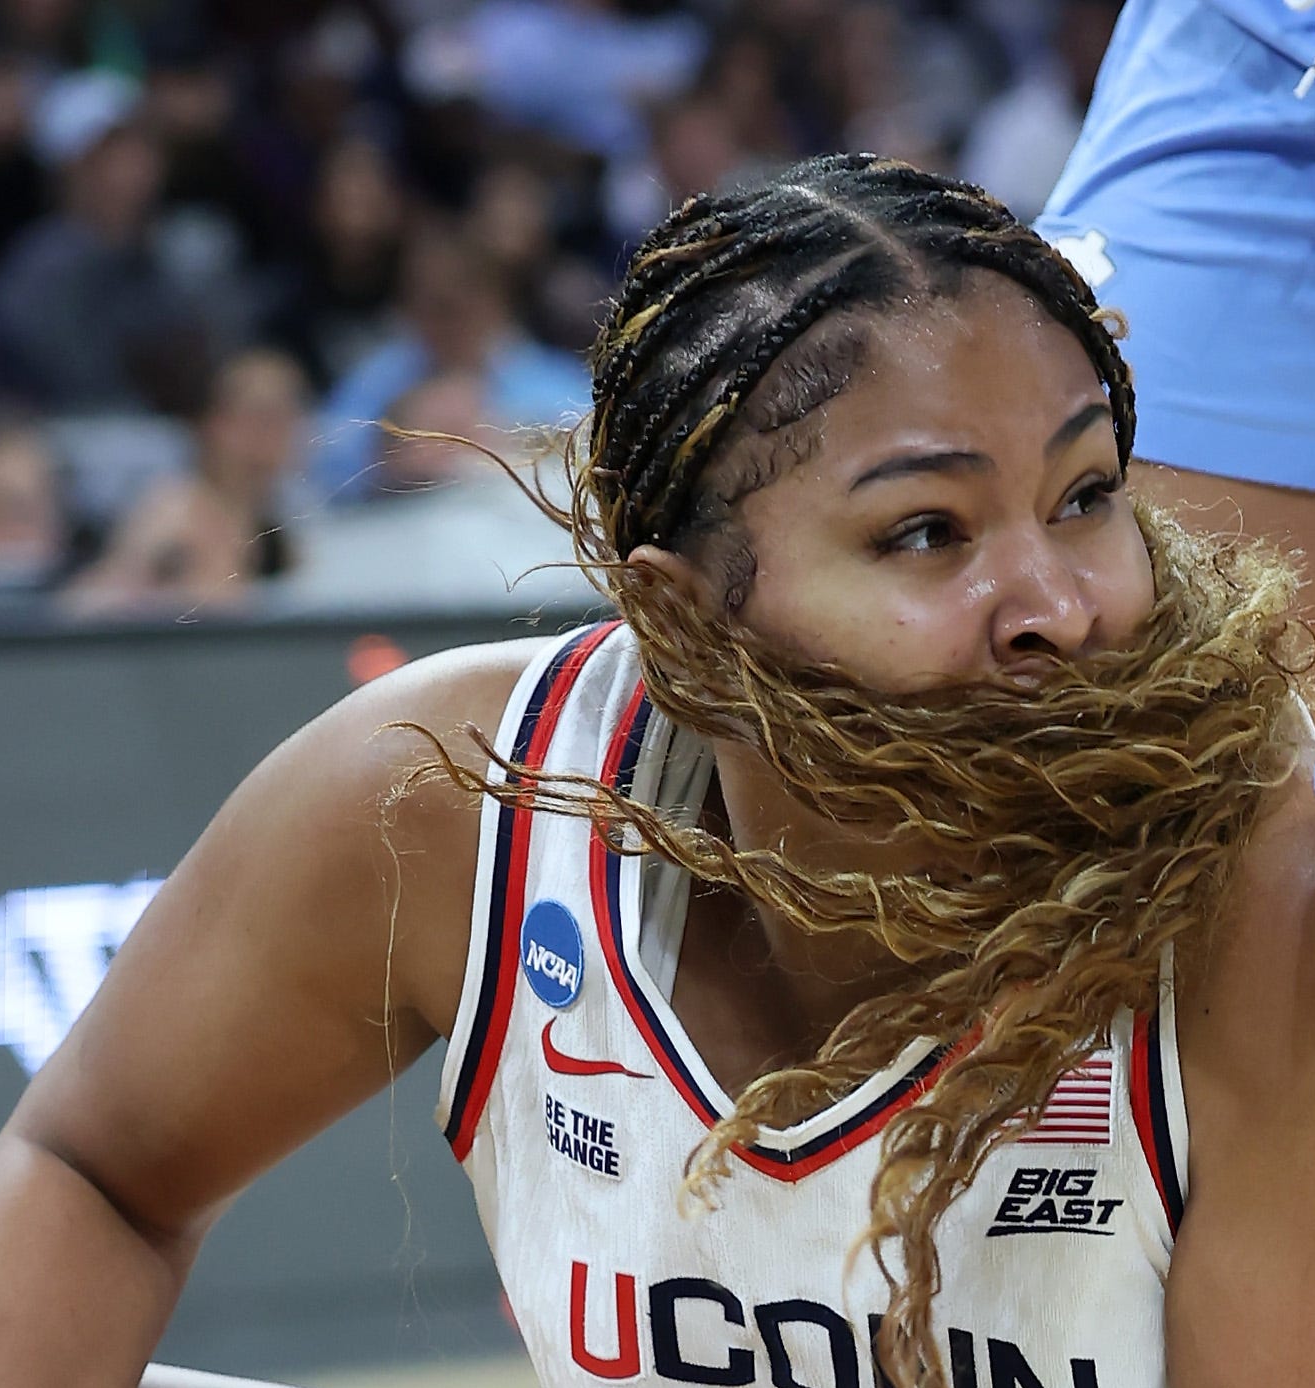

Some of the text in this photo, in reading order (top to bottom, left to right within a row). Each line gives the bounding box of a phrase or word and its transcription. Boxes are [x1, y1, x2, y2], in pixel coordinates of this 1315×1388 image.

[527, 939, 578, 993] NCAA
[545, 1093, 615, 1148] BE THE
[546, 1117, 620, 1177] HANGE
[1007, 1168, 1098, 1196] BIG
[994, 1197, 1125, 1225] EAST
